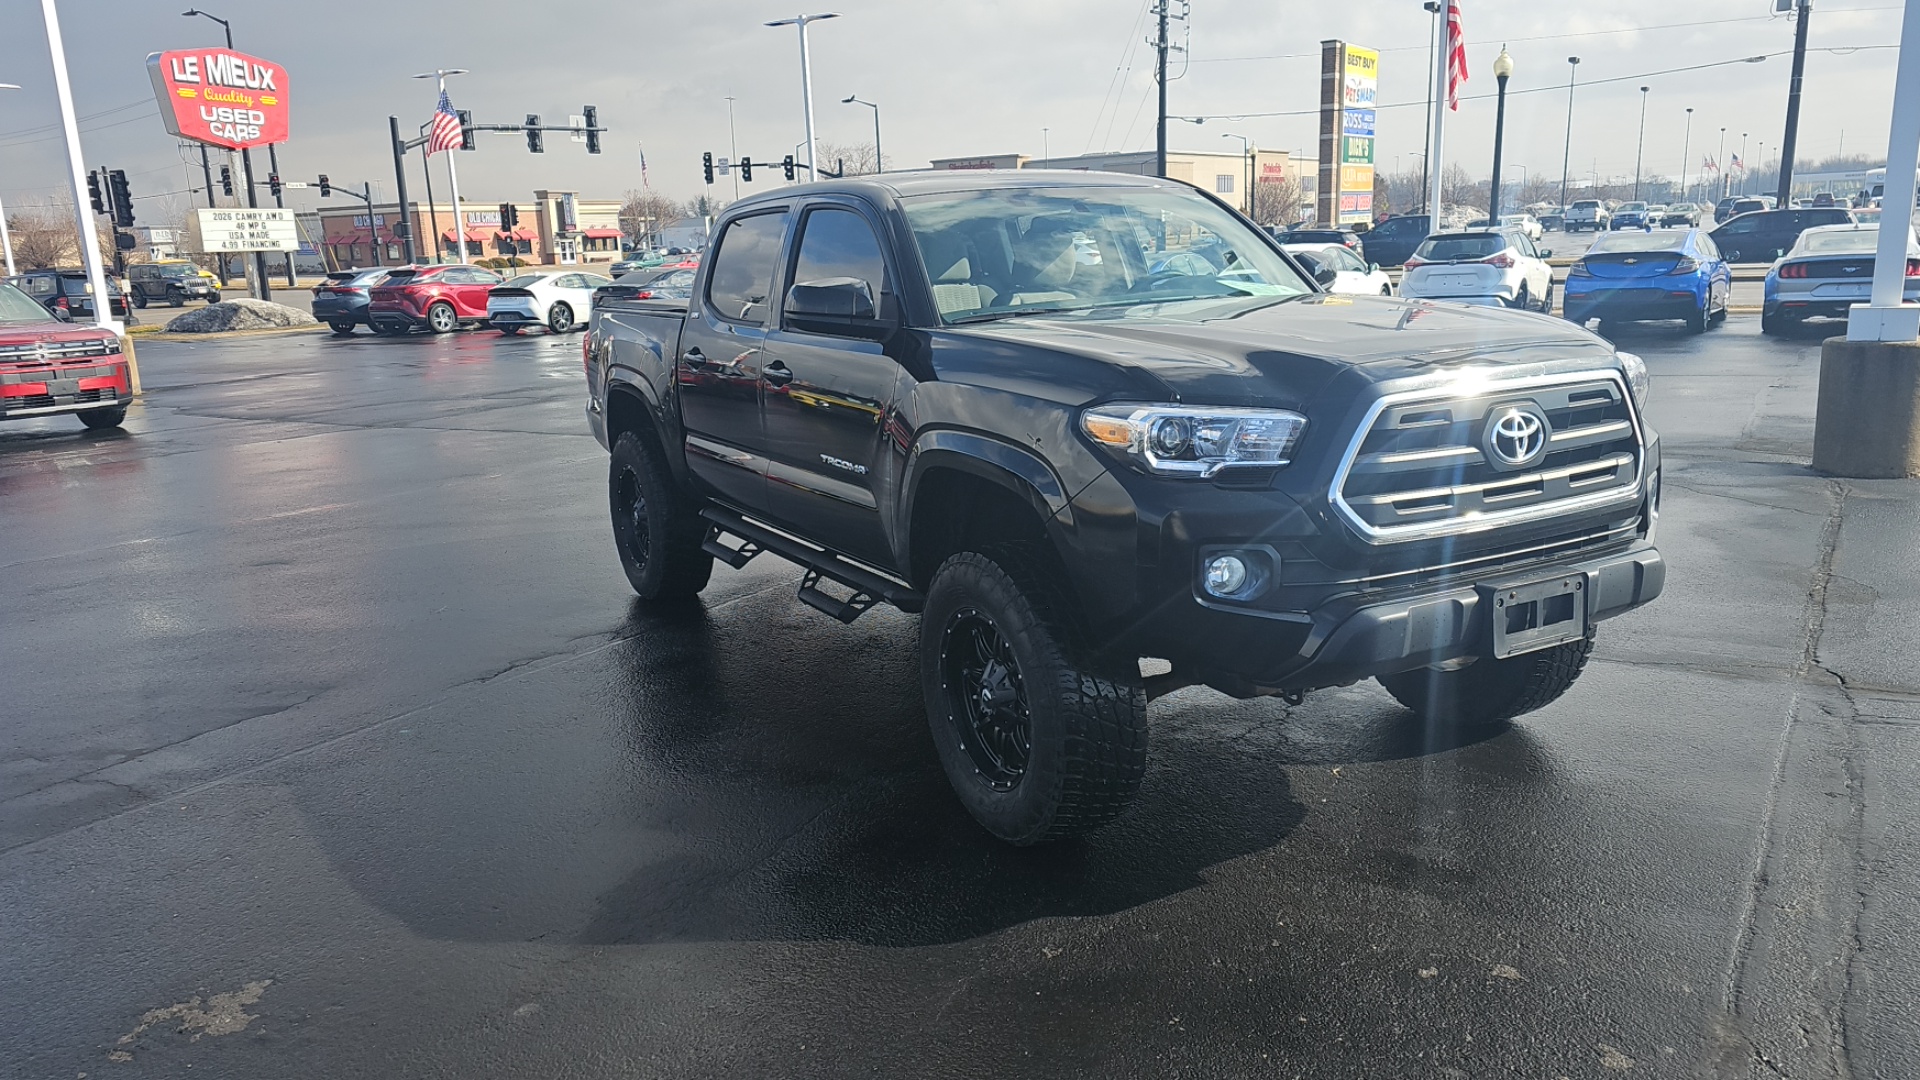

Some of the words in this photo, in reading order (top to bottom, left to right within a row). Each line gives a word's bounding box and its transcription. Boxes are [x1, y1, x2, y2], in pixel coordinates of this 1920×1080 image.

[1347, 53, 1362, 67] BEST
[1363, 57, 1376, 70] BUY
[171, 57, 201, 83] LE
[205, 55, 276, 90] MIEUX
[204, 88, 254, 108] Quality
[200, 105, 265, 125] USED
[1344, 112, 1362, 129] ROSS
[209, 122, 261, 142] CARS
[212, 212, 233, 221] 2026
[235, 212, 263, 221] CAMRY
[468, 211, 481, 223] OLD
[236, 221, 245, 230] 46
[229, 231, 245, 240] USA
[249, 231, 270, 240] MADE
[221, 241, 239, 249] 4.99
[242, 240, 281, 249] FINANCING
[820, 454, 869, 475] TACOMA
